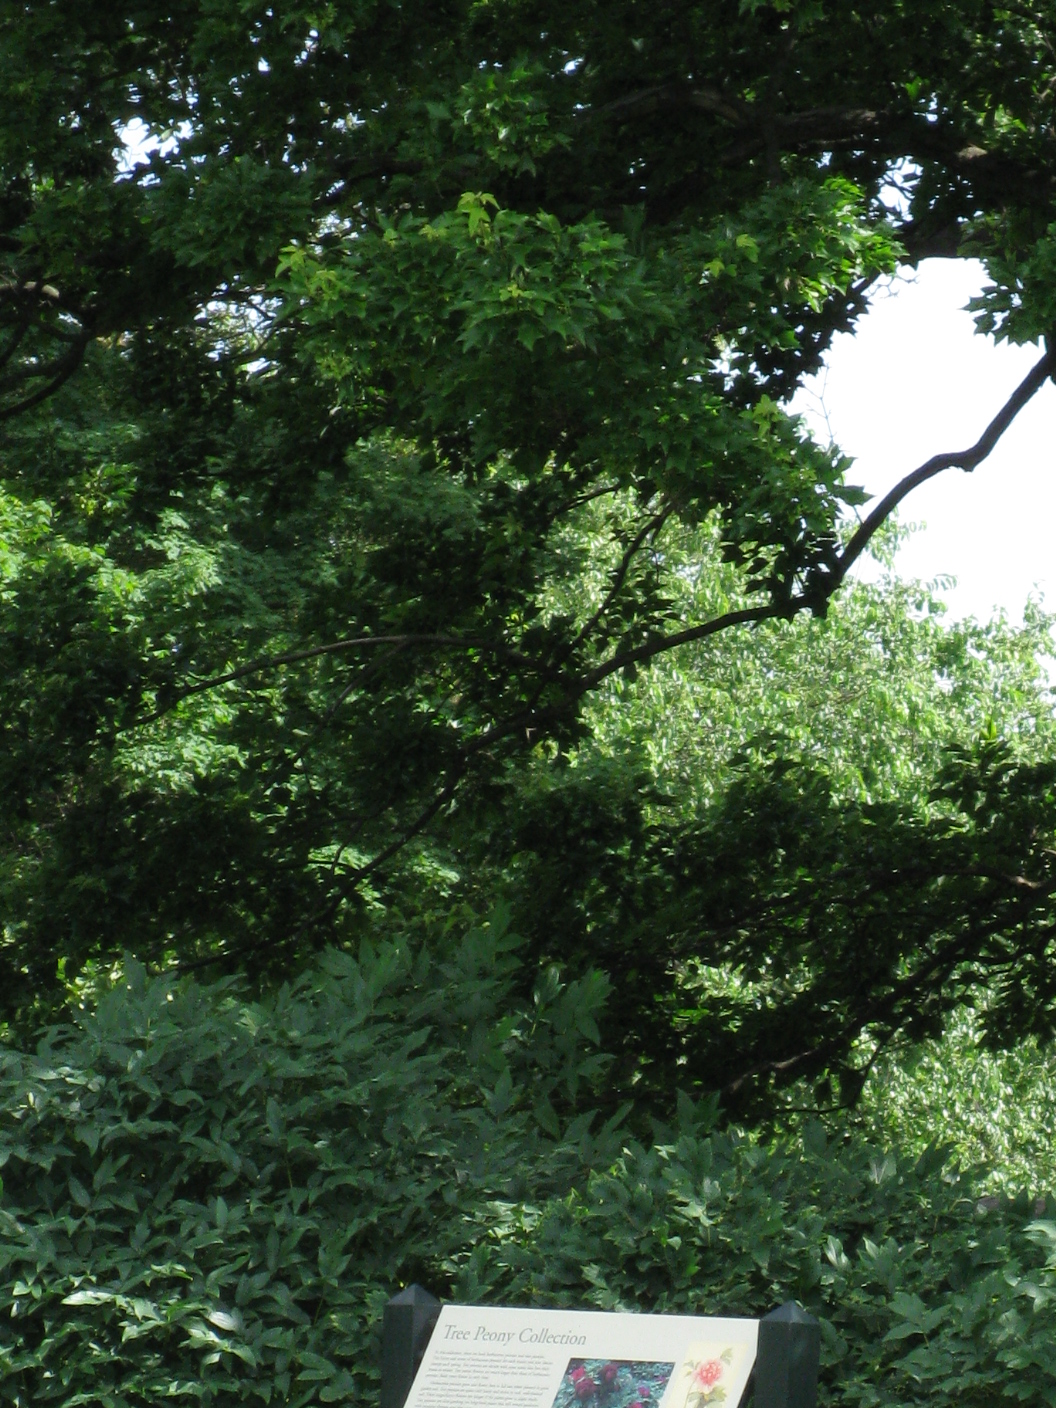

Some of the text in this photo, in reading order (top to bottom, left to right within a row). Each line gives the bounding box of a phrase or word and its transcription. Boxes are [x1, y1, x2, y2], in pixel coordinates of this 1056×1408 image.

[444, 1324, 587, 1346] Tree Peony Collection
